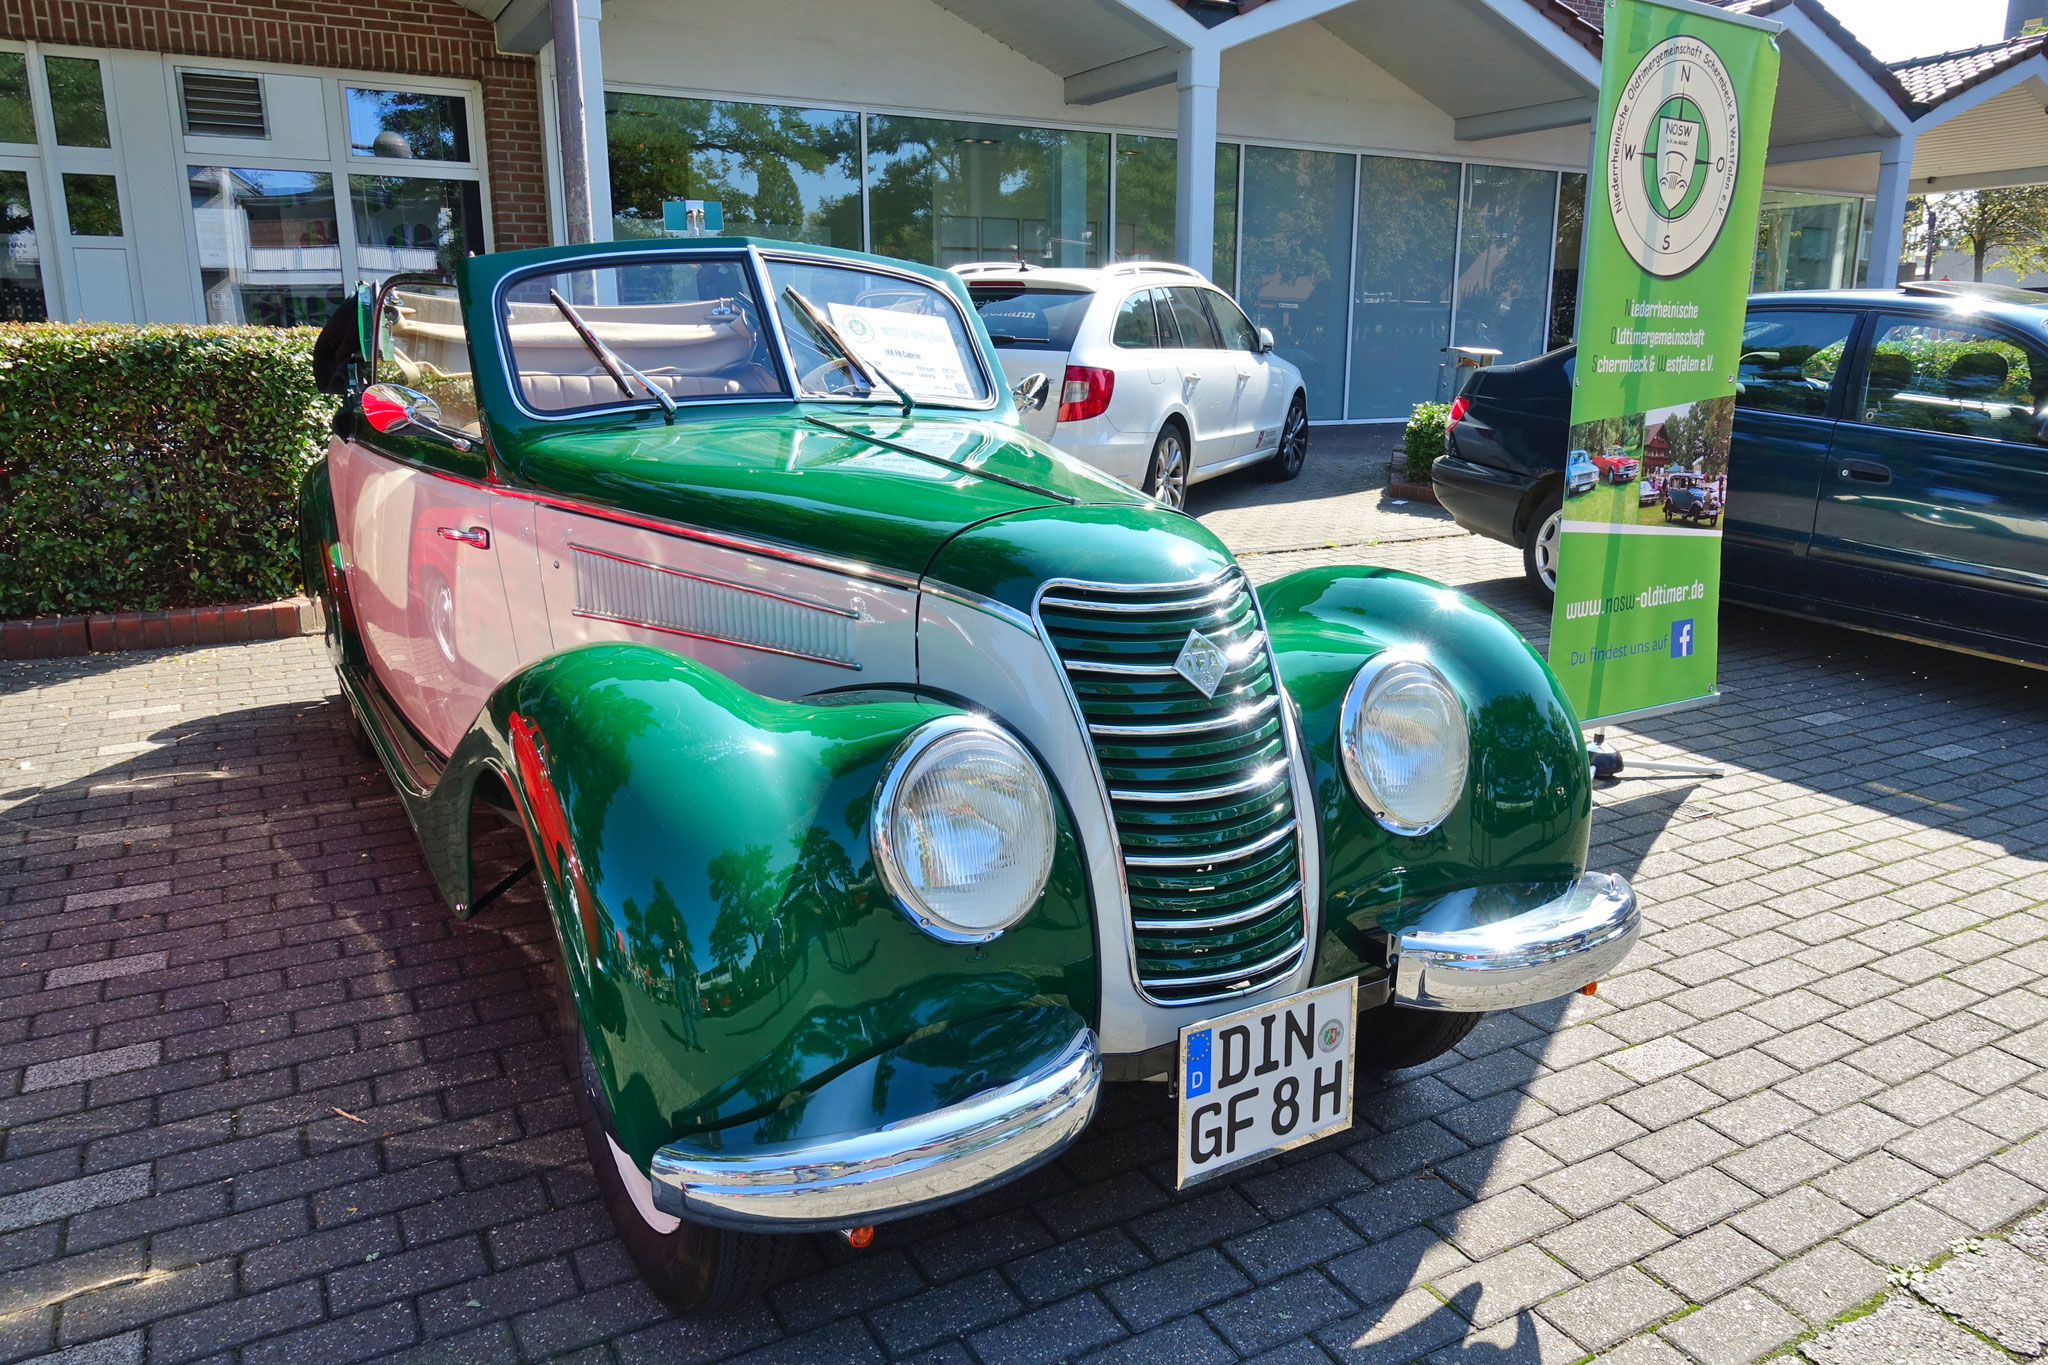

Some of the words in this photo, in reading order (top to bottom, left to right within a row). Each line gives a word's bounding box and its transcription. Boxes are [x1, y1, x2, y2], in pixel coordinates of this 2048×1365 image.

[1627, 43, 1703, 101] Oldtimergemeinschaft
[1680, 64, 1691, 83] N
[1703, 53, 1735, 111] Schermbeck
[1729, 113, 1736, 122] &
[1665, 122, 1693, 138] NOSW
[1608, 104, 1632, 214] Niederrheinische
[1624, 143, 1636, 161] W
[1723, 126, 1737, 196] Westfalen
[1715, 157, 1725, 173] O
[1661, 234, 1671, 251] S
[1624, 298, 1699, 319] Niederrheinische
[1610, 327, 1705, 348] Oldtimergemeinschaft
[1592, 354, 1648, 373] Schermbeck
[1649, 357, 1655, 372] &
[1657, 354, 1699, 375] Westfalen
[1700, 354, 1714, 372] e.V.
[1566, 579, 1704, 619] www.nosw-oldtimer.de
[1571, 651, 1586, 666] Du
[1590, 645, 1628, 662] findest
[1630, 641, 1650, 655] uns
[1652, 633, 1668, 651] auf
[1218, 1003, 1315, 1089] DIN
[1191, 1071, 1203, 1089] D
